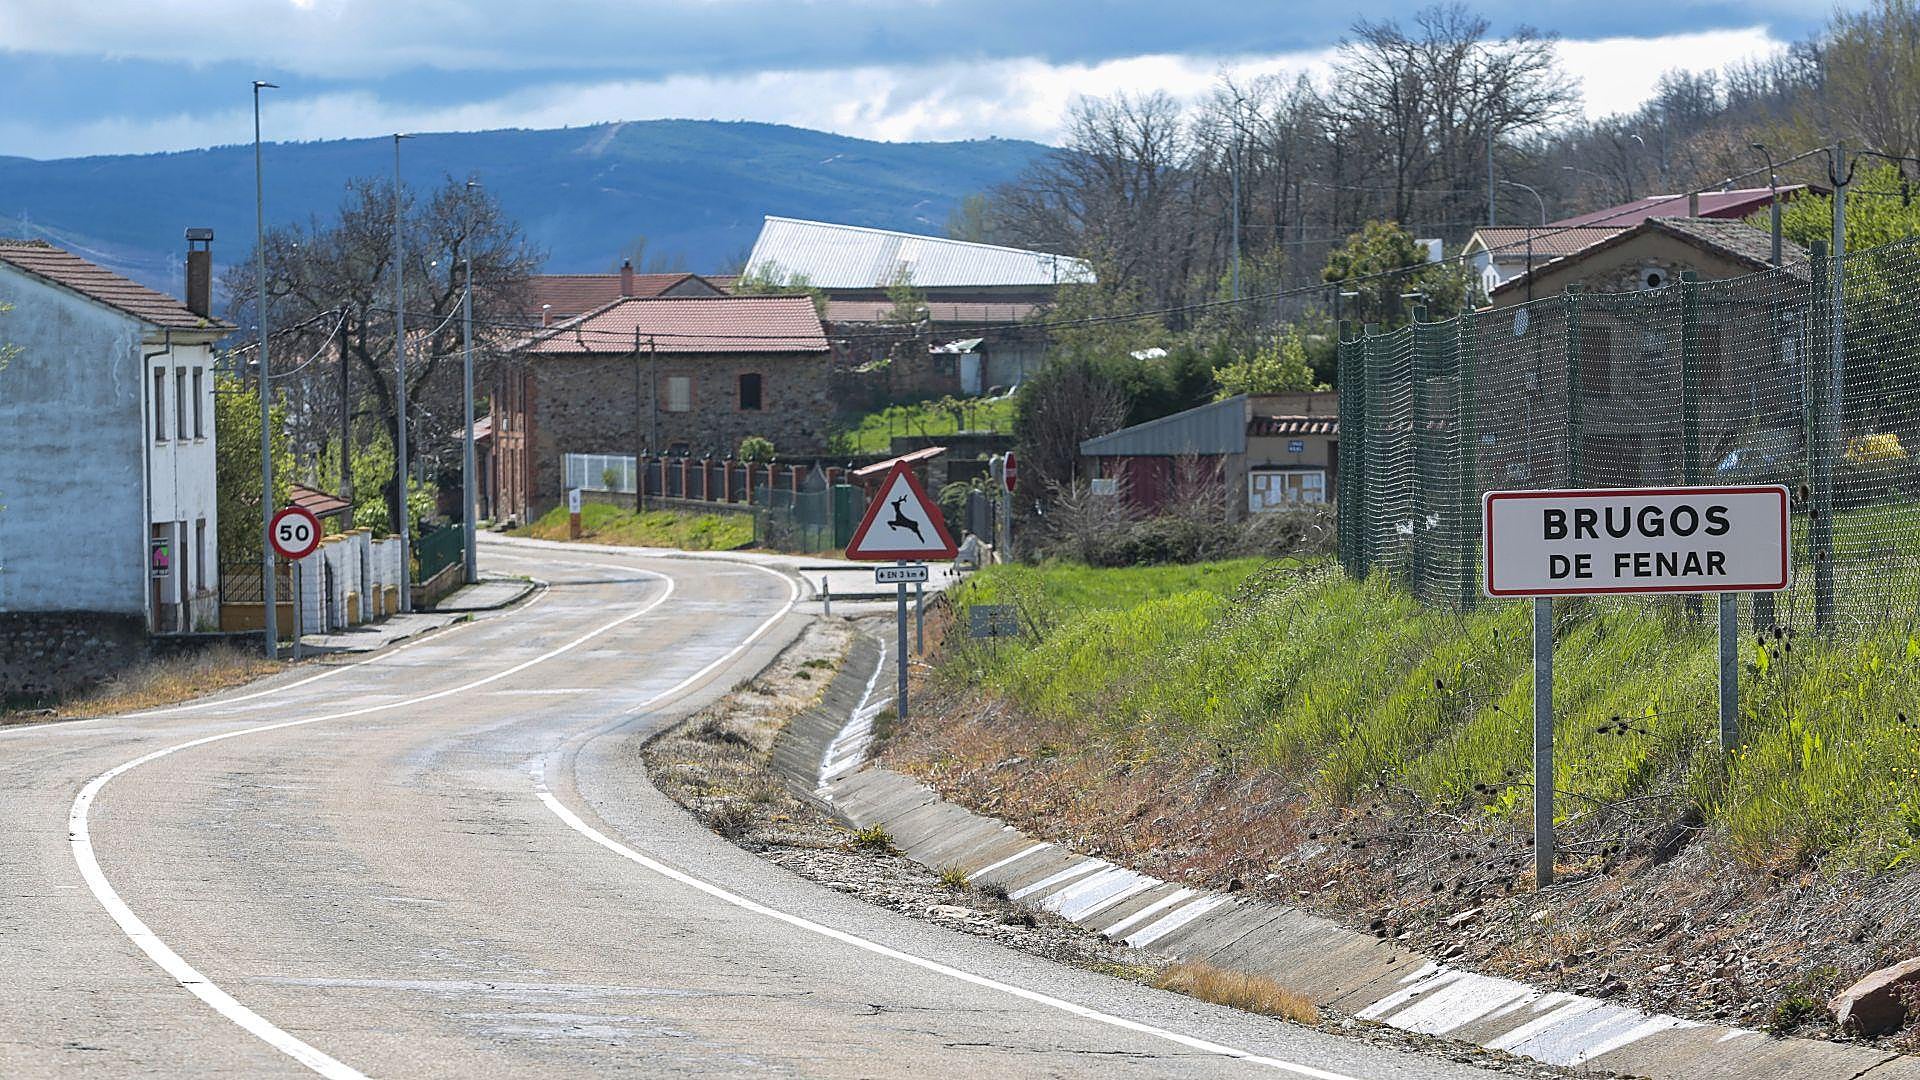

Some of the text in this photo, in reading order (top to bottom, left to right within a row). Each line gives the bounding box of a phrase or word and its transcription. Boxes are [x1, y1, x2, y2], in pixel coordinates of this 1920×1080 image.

[280, 524, 309, 542] 50
[1543, 505, 1731, 540] BRUGOS
[887, 571, 898, 579] EN
[1549, 550, 1727, 580] DE FENAR
